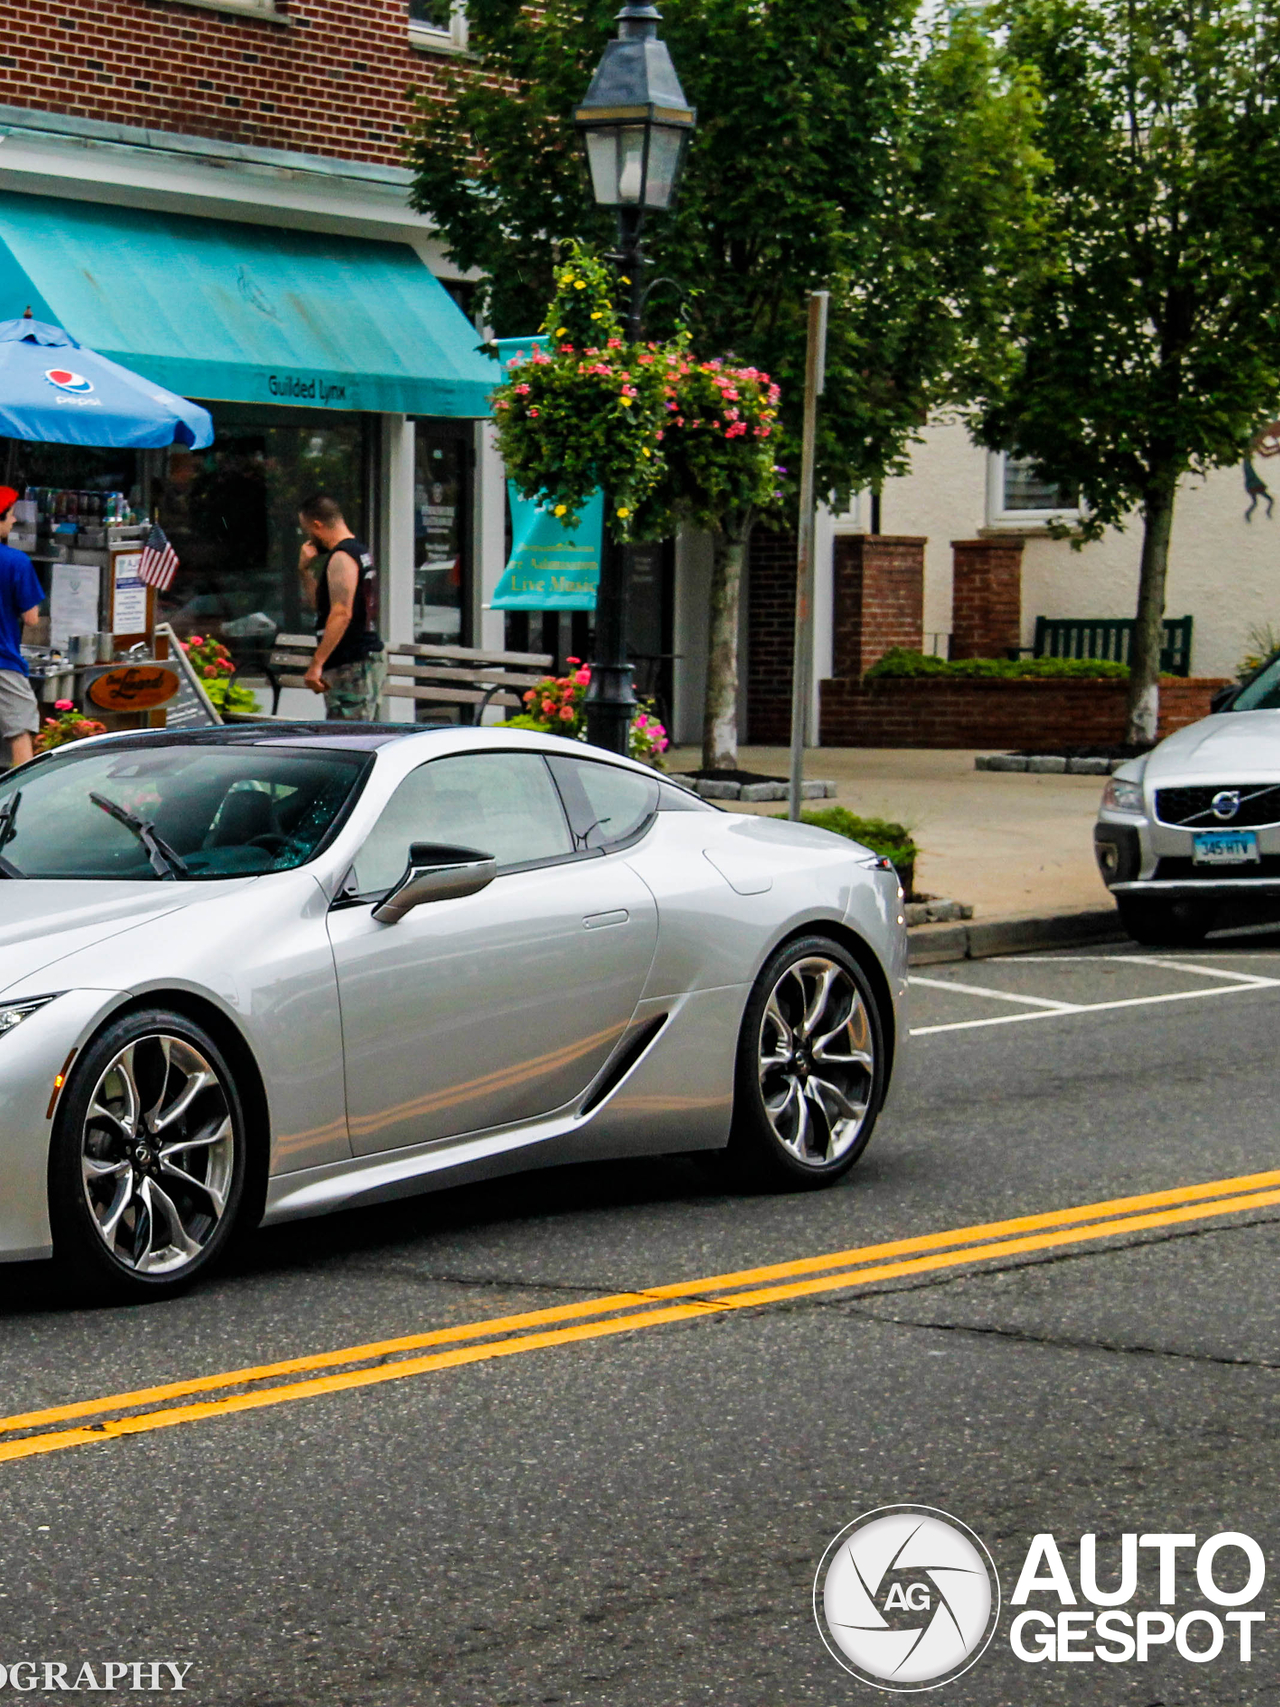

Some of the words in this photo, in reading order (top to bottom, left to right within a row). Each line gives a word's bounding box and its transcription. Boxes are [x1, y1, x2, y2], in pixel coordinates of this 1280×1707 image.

[268, 375, 316, 398] Guilded
[54, 395, 103, 407] pepsi
[511, 575, 545, 592] Live
[549, 575, 598, 592] Music
